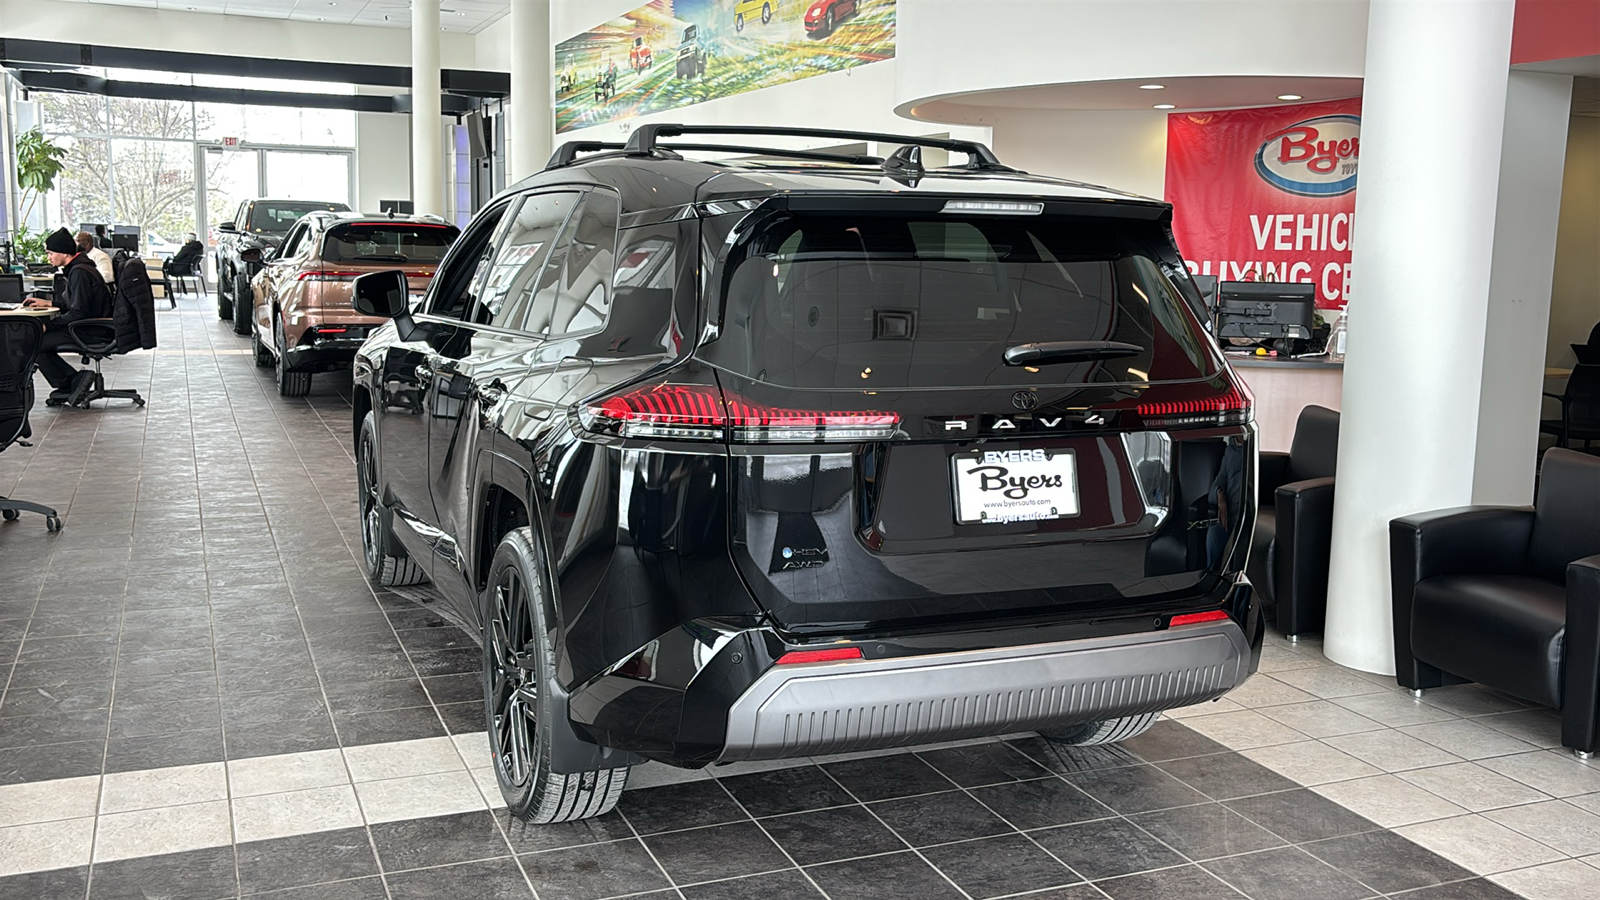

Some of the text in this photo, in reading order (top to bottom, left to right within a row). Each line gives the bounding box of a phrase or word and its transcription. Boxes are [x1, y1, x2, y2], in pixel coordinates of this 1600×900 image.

[1341, 163, 1358, 175] TOY
[1250, 212, 1354, 252] VEHIC
[945, 415, 1104, 430] RAV4
[984, 449, 1046, 464] BYERS
[966, 465, 1063, 500] Byers
[983, 499, 1052, 509] www.byersauto.com
[782, 560, 825, 570] AWD
